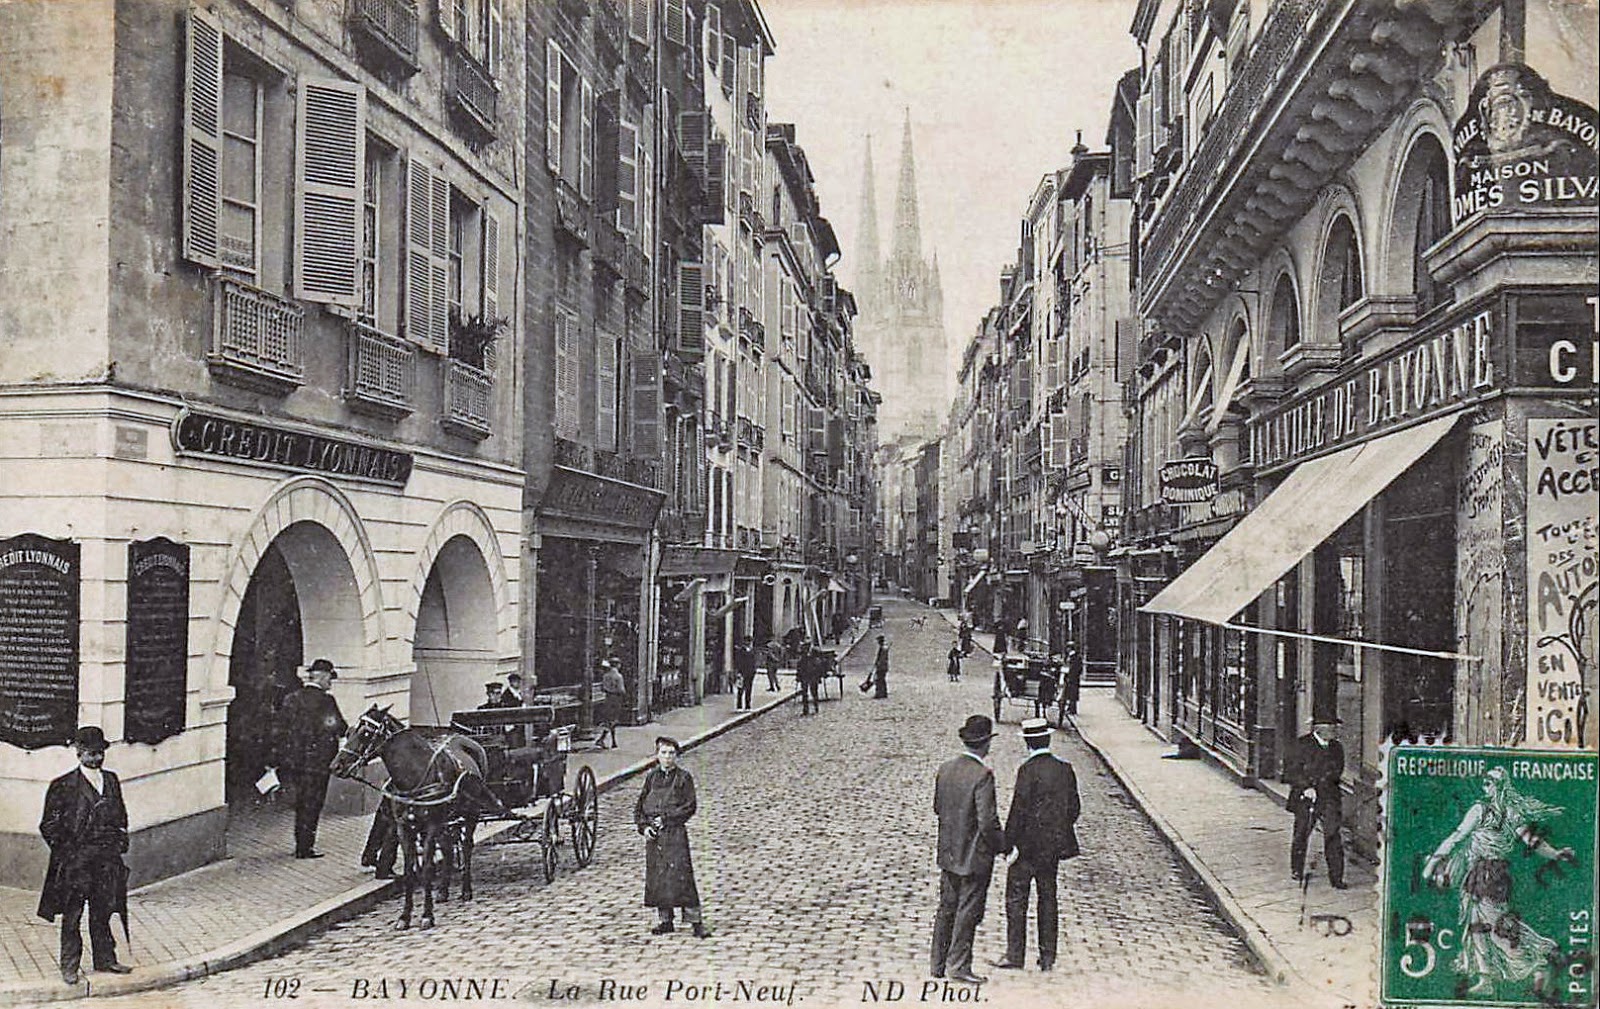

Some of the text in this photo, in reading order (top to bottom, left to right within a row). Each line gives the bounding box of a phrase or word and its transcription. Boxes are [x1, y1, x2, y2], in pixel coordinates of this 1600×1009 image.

[1454, 119, 1479, 153] VILLE
[1471, 160, 1549, 187] MAISON
[1283, 395, 1326, 458] VILLE
[1332, 379, 1357, 440] DE
[1367, 310, 1494, 427] BAYONNE
[303, 439, 400, 481] LYONNAIS
[1160, 462, 1217, 483] CHOCOLAT
[1162, 482, 1219, 502] DOMINIQUE
[25, 550, 70, 574] LYONNAIS
[1538, 652, 1566, 675] EN
[1537, 679, 1582, 703] VENTE
[1512, 761, 1595, 781] FRANÇAISE
